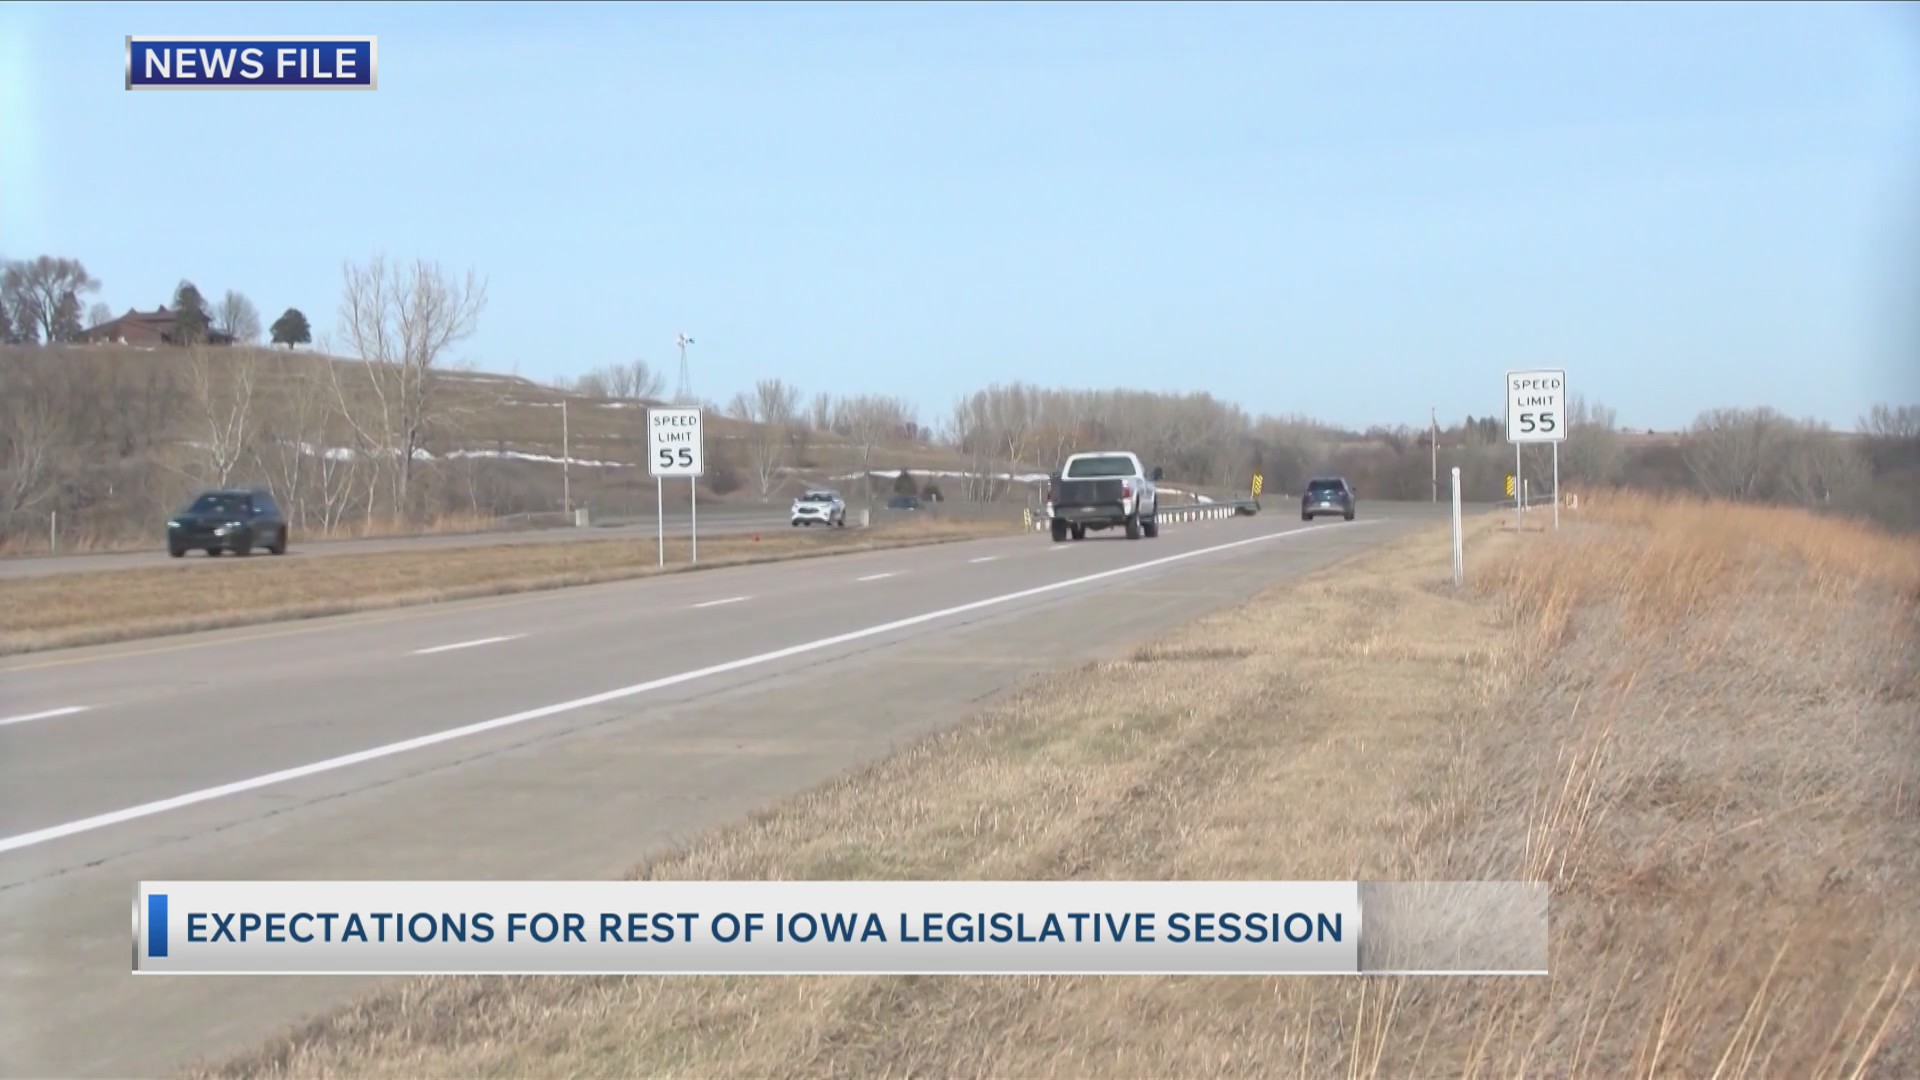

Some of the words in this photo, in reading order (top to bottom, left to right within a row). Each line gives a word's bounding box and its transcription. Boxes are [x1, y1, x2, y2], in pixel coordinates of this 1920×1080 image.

[1513, 378, 1560, 390] SPEED
[1517, 396, 1554, 407] LIMIT
[654, 415, 697, 427] SPEED
[1520, 412, 1555, 433] 55
[658, 431, 692, 442] LIMIT
[660, 447, 693, 468] 55
